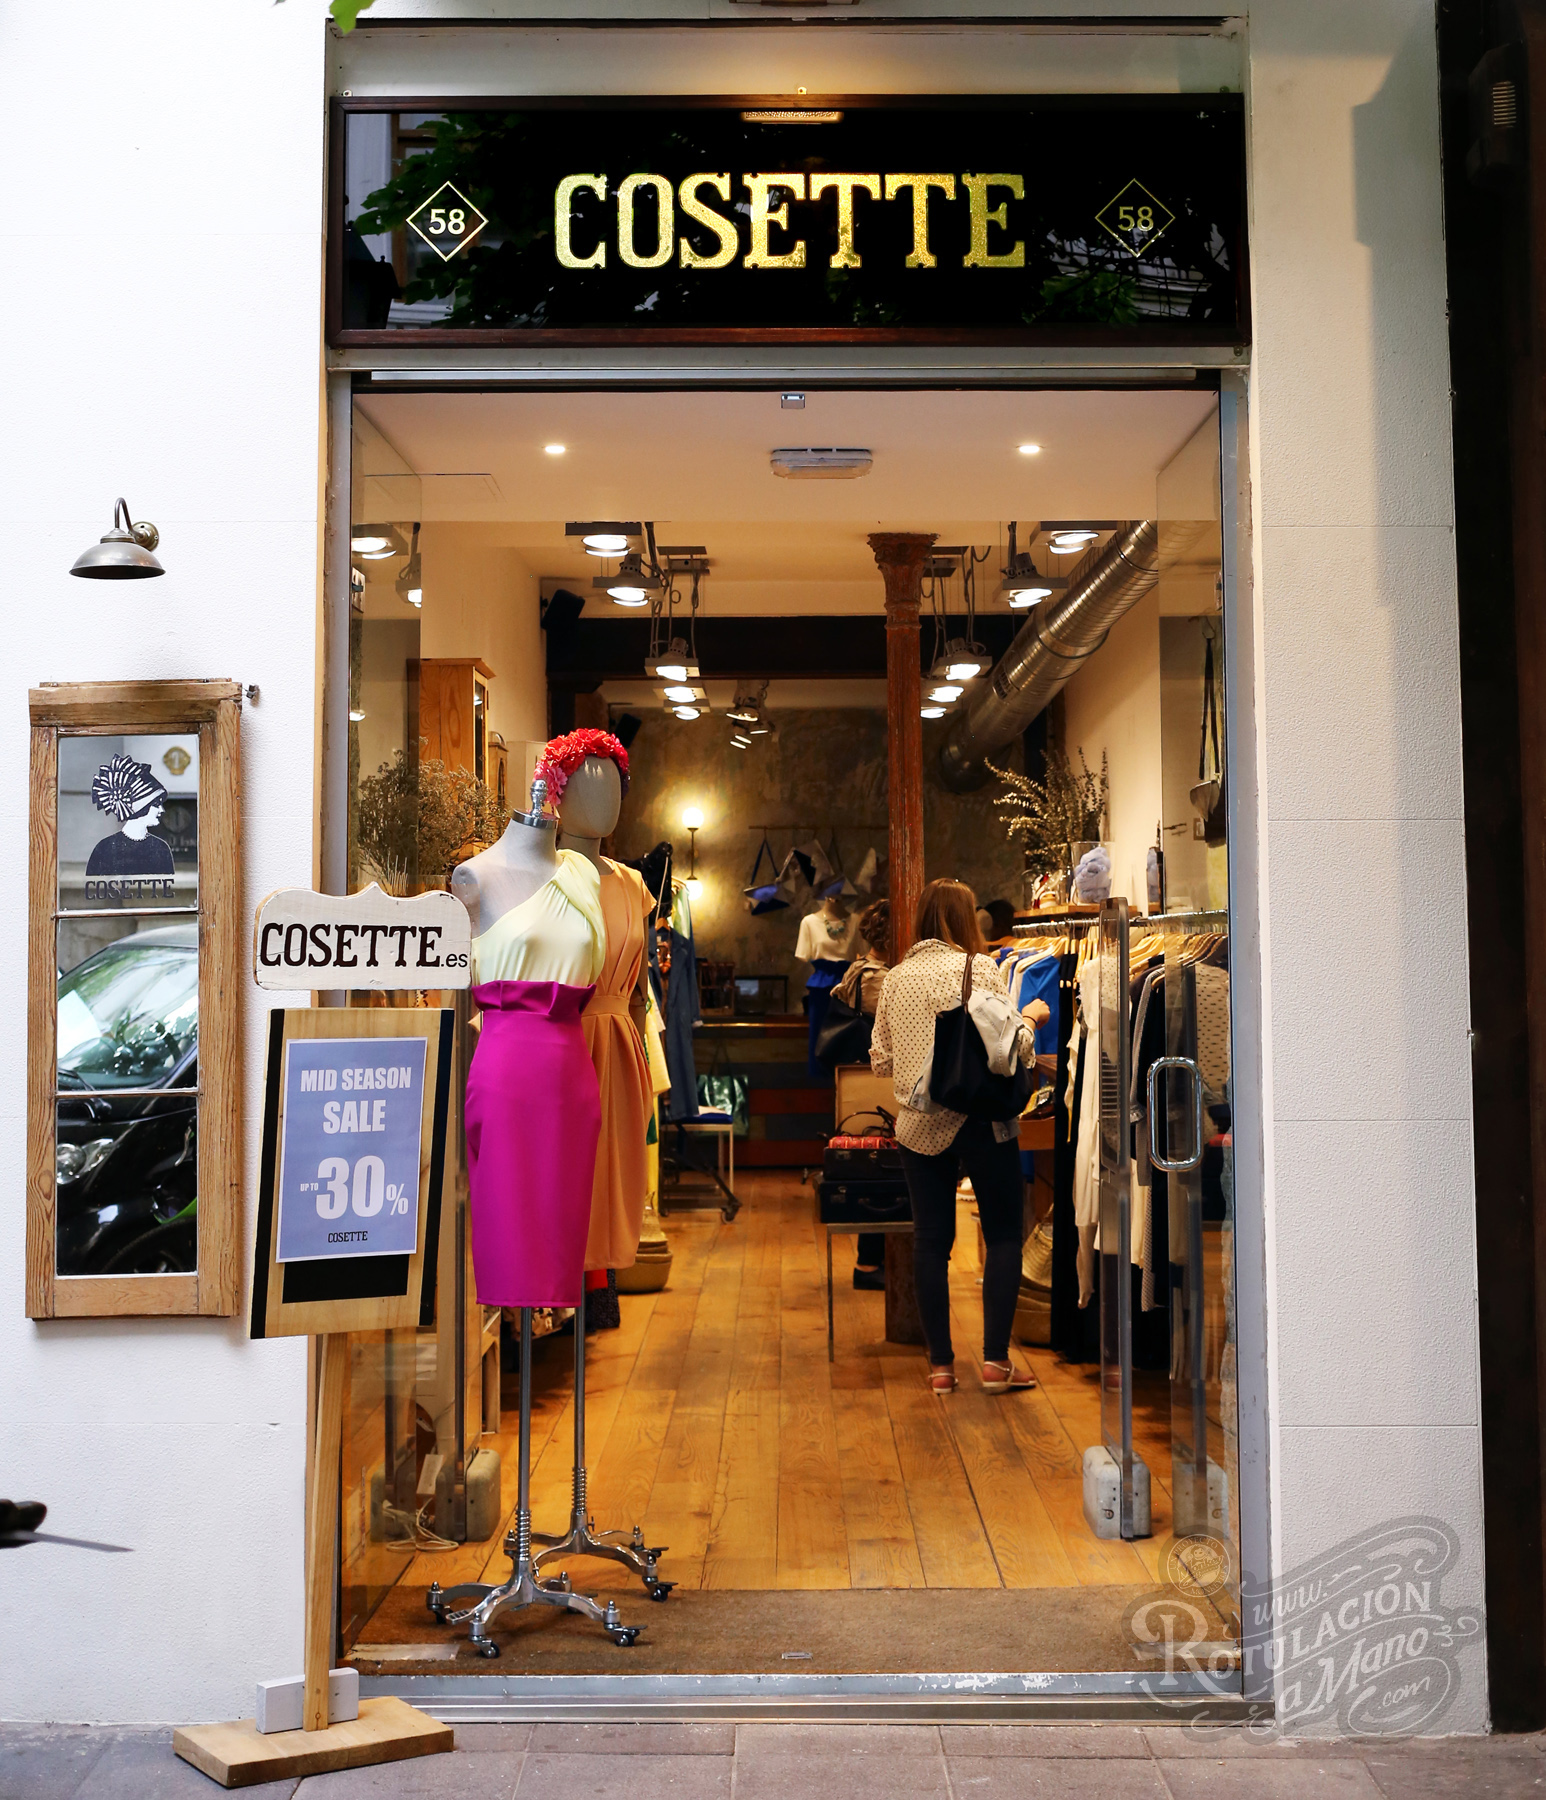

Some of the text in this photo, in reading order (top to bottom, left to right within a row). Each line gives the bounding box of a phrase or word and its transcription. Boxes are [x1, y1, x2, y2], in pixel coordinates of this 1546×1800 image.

[429, 208, 466, 235] 58
[554, 172, 1026, 269] COSETTE
[1117, 206, 1155, 232] 58
[85, 879, 175, 900] COSETTE
[260, 922, 469, 968] COSETTE.es
[301, 1066, 412, 1092] MID SEASON
[323, 1099, 387, 1135] SALE
[300, 1183, 310, 1192] UP
[310, 1182, 319, 1191] TO
[327, 1231, 369, 1244] COSETTE
